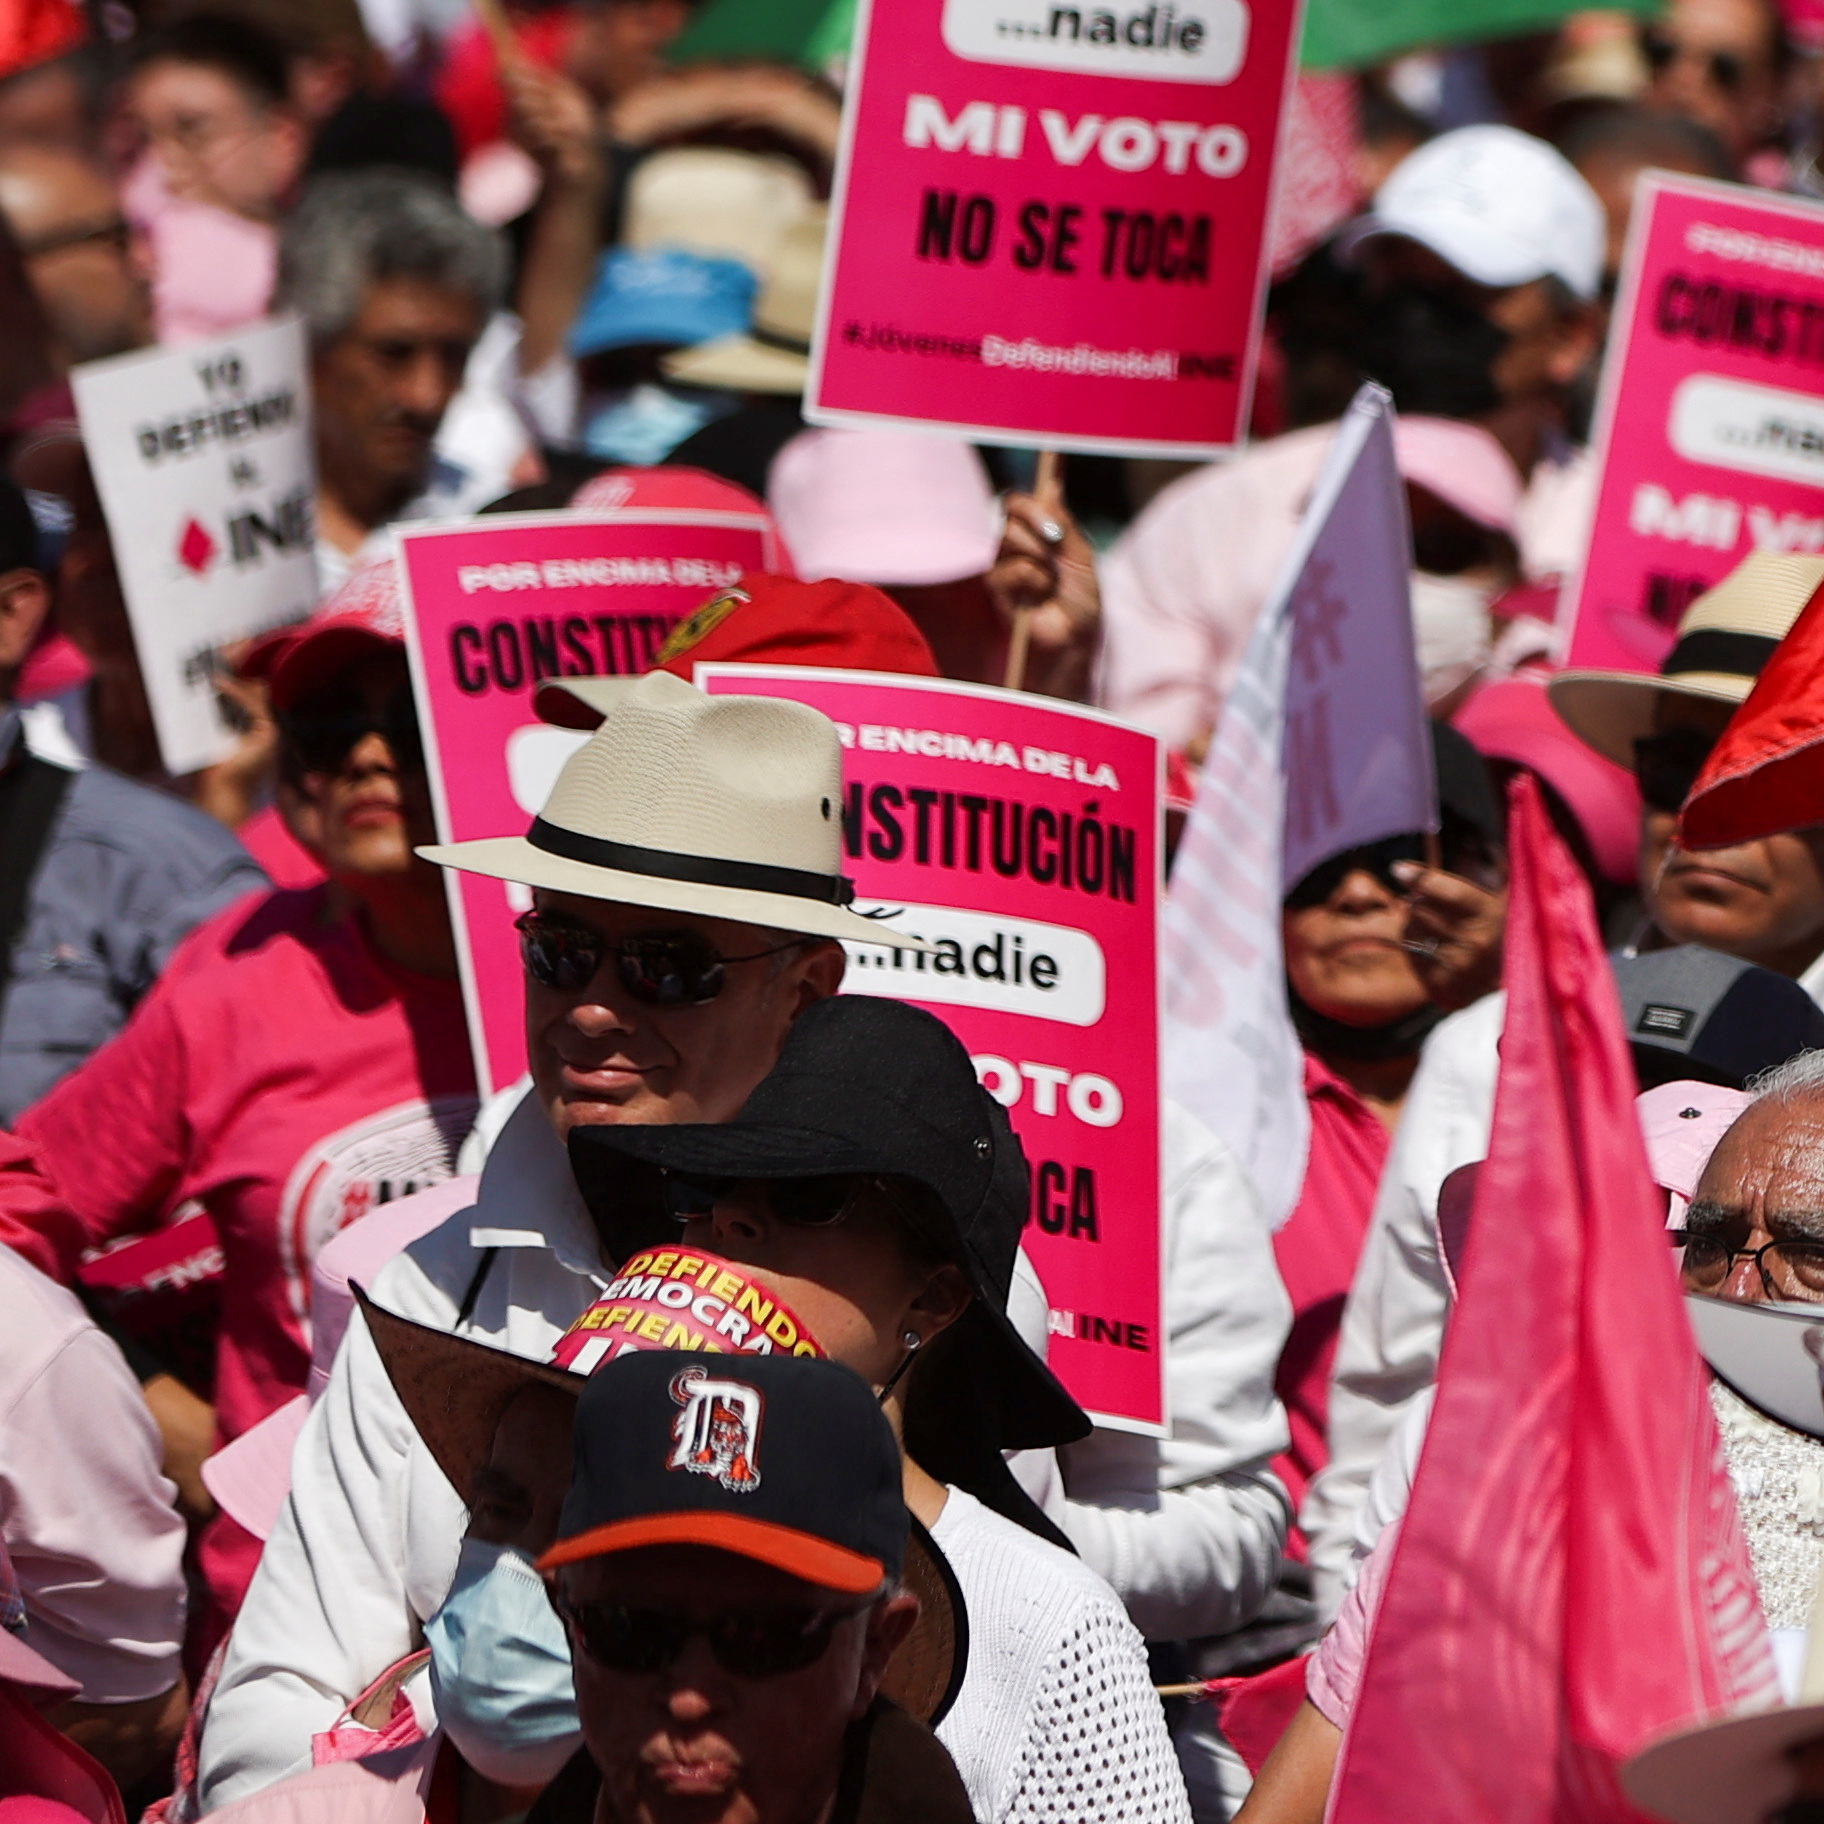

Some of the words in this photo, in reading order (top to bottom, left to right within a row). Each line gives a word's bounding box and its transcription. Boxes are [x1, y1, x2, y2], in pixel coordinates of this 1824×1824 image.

[904, 94, 1025, 161] MI
[1039, 110, 1250, 179] VOTO
[917, 189, 997, 265] NO
[1012, 201, 1086, 275] SE
[1099, 208, 1213, 286] TOCA
[858, 723, 1020, 770] ENCIMA
[1021, 745, 1072, 780] DE
[1074, 754, 1121, 791] LA
[842, 780, 1137, 904] NSTITUCIÓN
[969, 1053, 1125, 1128] OTO
[600, 1275, 775, 1357] EMOCRA
